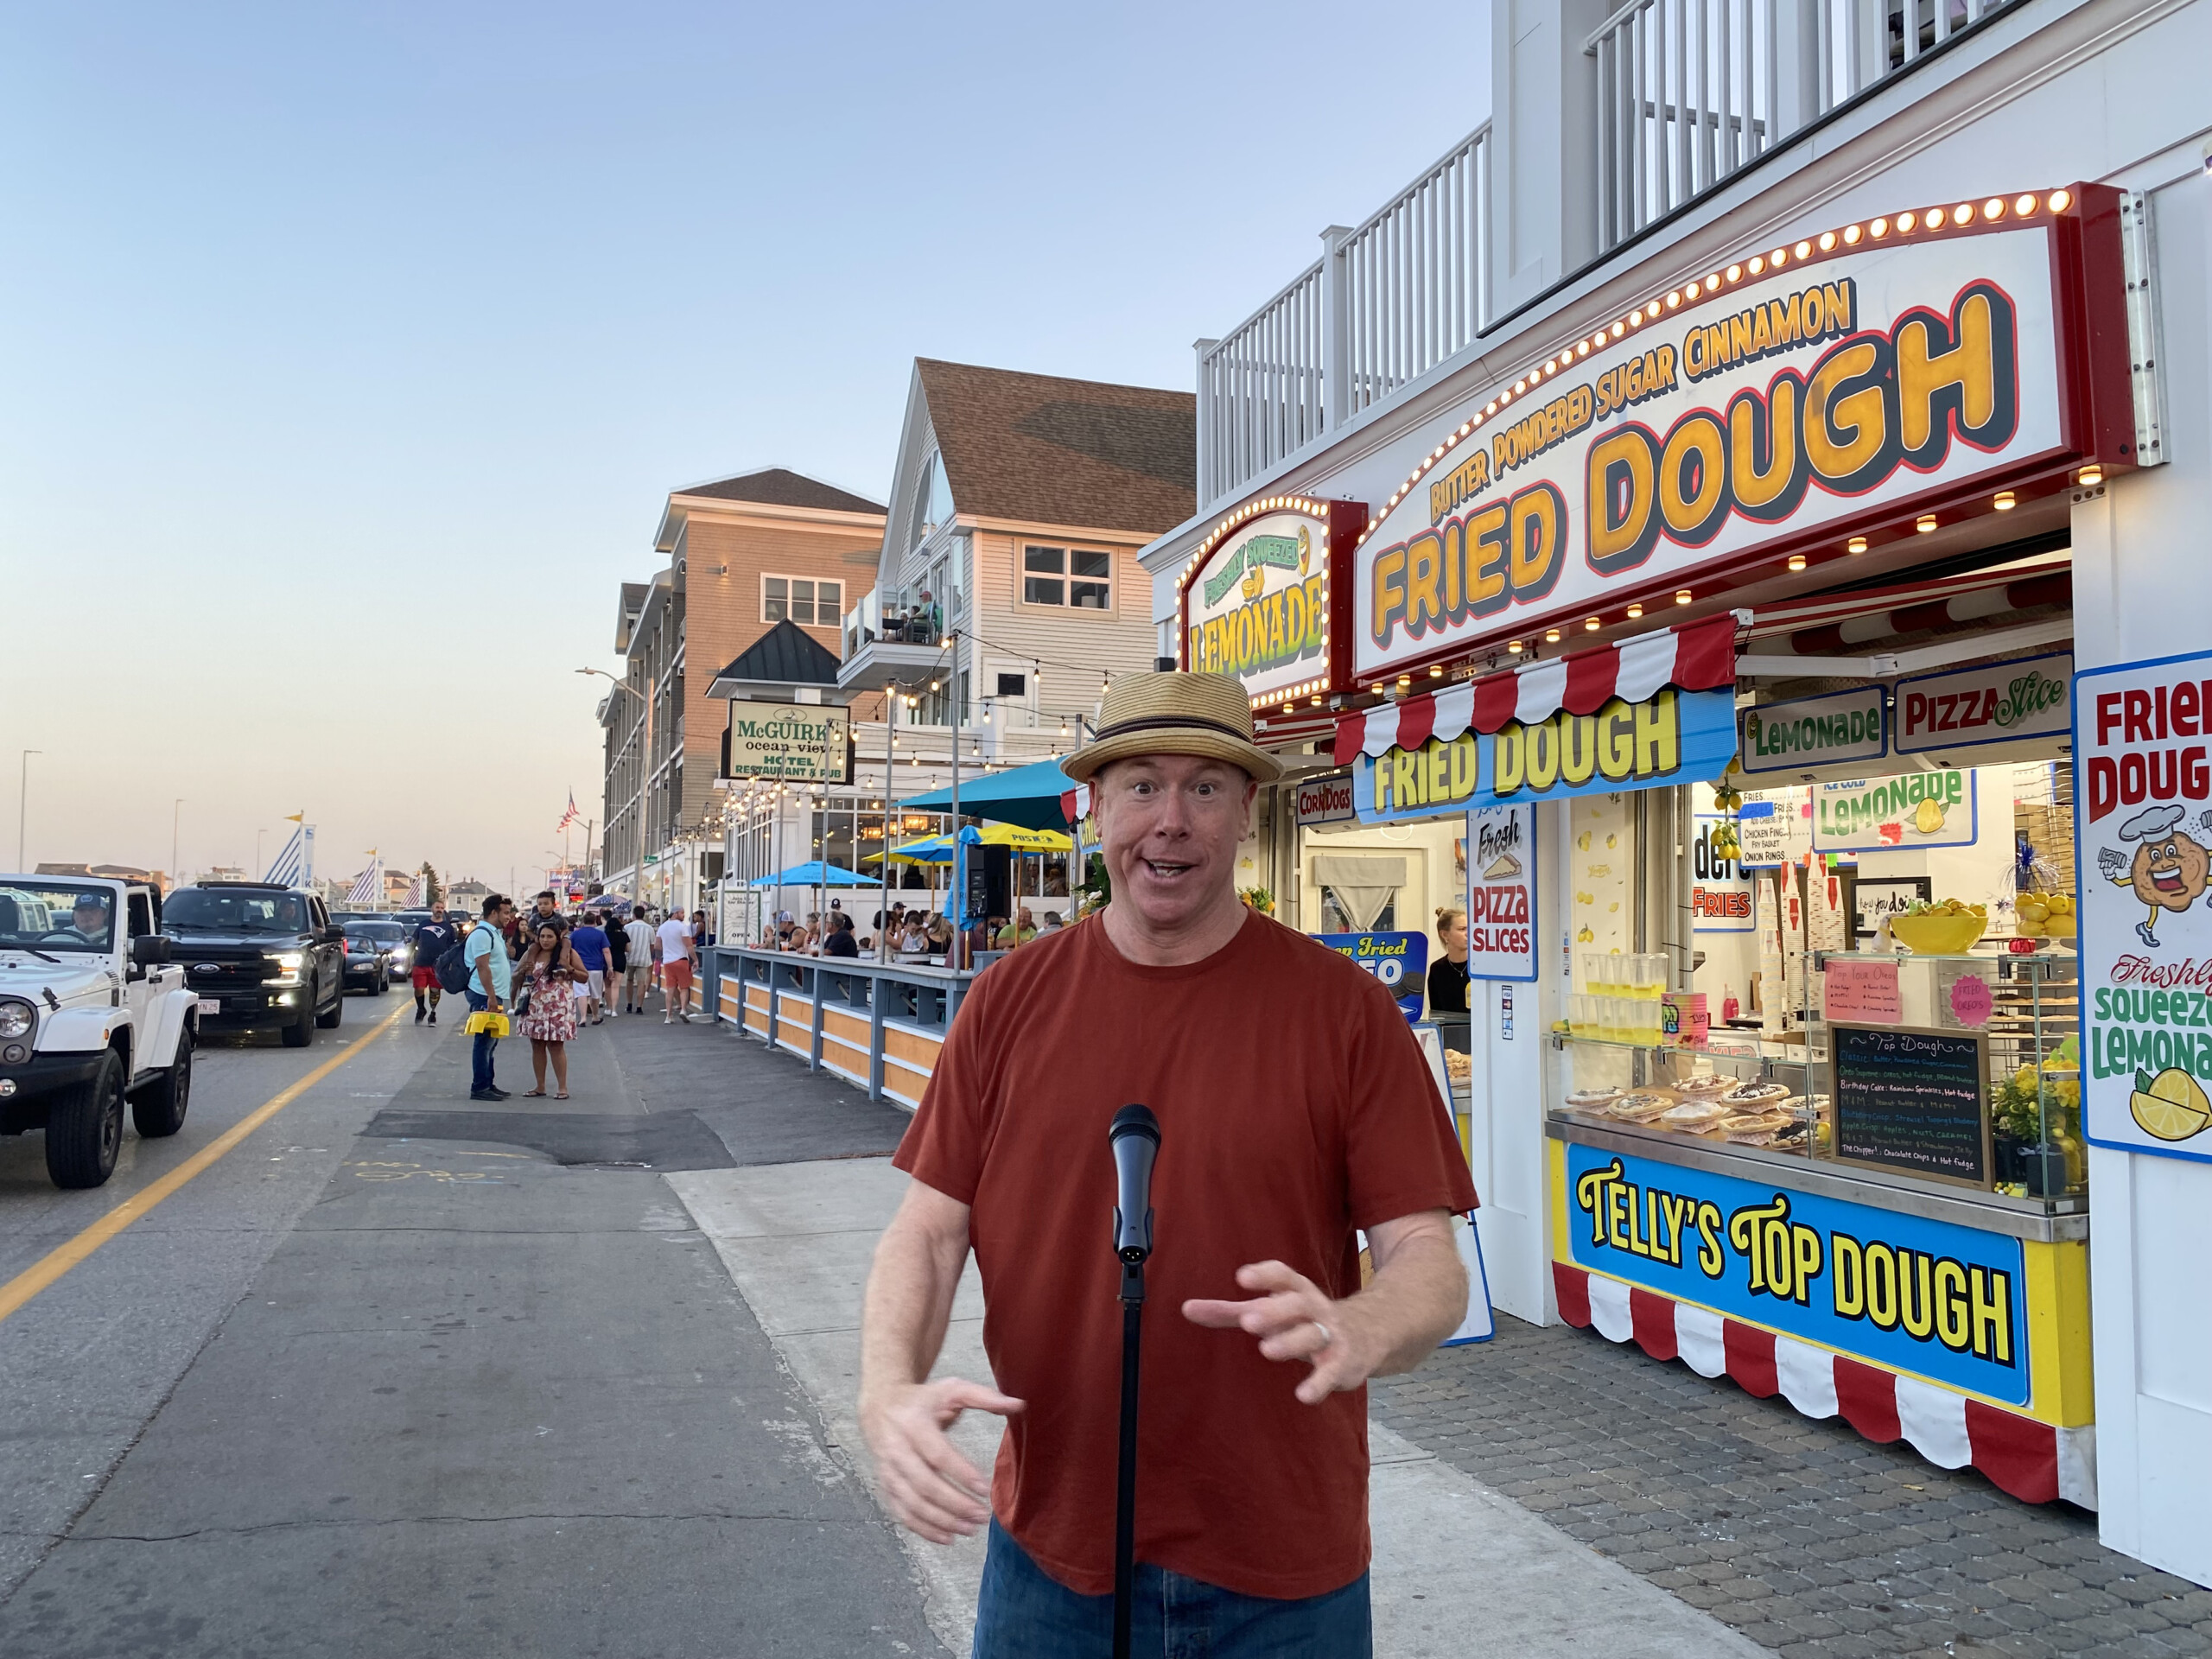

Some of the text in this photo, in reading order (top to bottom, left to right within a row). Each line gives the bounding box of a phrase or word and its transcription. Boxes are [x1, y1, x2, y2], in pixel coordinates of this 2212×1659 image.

[1430, 277, 1857, 525] BUTTER POWDERED SUGAR CINNAMON
[1372, 279, 2018, 648] FRIED DOUGH
[1205, 534, 1299, 609] FRESHLY SQUEEZED
[1190, 573, 1324, 677] LEMONADE
[1905, 671, 2065, 736] PIZZA Slice
[746, 741, 790, 752] ocean
[1375, 689, 1681, 814] FRIED DOUGH
[764, 755, 815, 766] HOTEL
[1325, 787, 1351, 810] DOGS
[1744, 791, 1764, 802] FRIES
[1477, 809, 1520, 866] Fresh
[1745, 827, 1790, 839] CHICKEN FING
[1762, 840, 1780, 849] BASKET
[1745, 850, 1785, 861] ONION RINGS
[1694, 887, 1751, 918] FRIES
[1874, 897, 1889, 915] you
[1889, 891, 1911, 912] doi
[1357, 937, 1408, 957] Fried
[1958, 985, 1980, 995] FRIED
[1869, 1033, 1954, 1057] Top Dough
[1840, 1079, 1869, 1094] Birthday
[1889, 1084, 1914, 1093] Rainbow
[1956, 1089, 1975, 1101] fudge
[1884, 1149, 1912, 1159] Chocolate
[1913, 1152, 1929, 1162] Chips
[1940, 1156, 1952, 1166] Hot
[1954, 1158, 1975, 1171] fudge
[1576, 1156, 2016, 1370] TELLY'S TOP DOUGH
